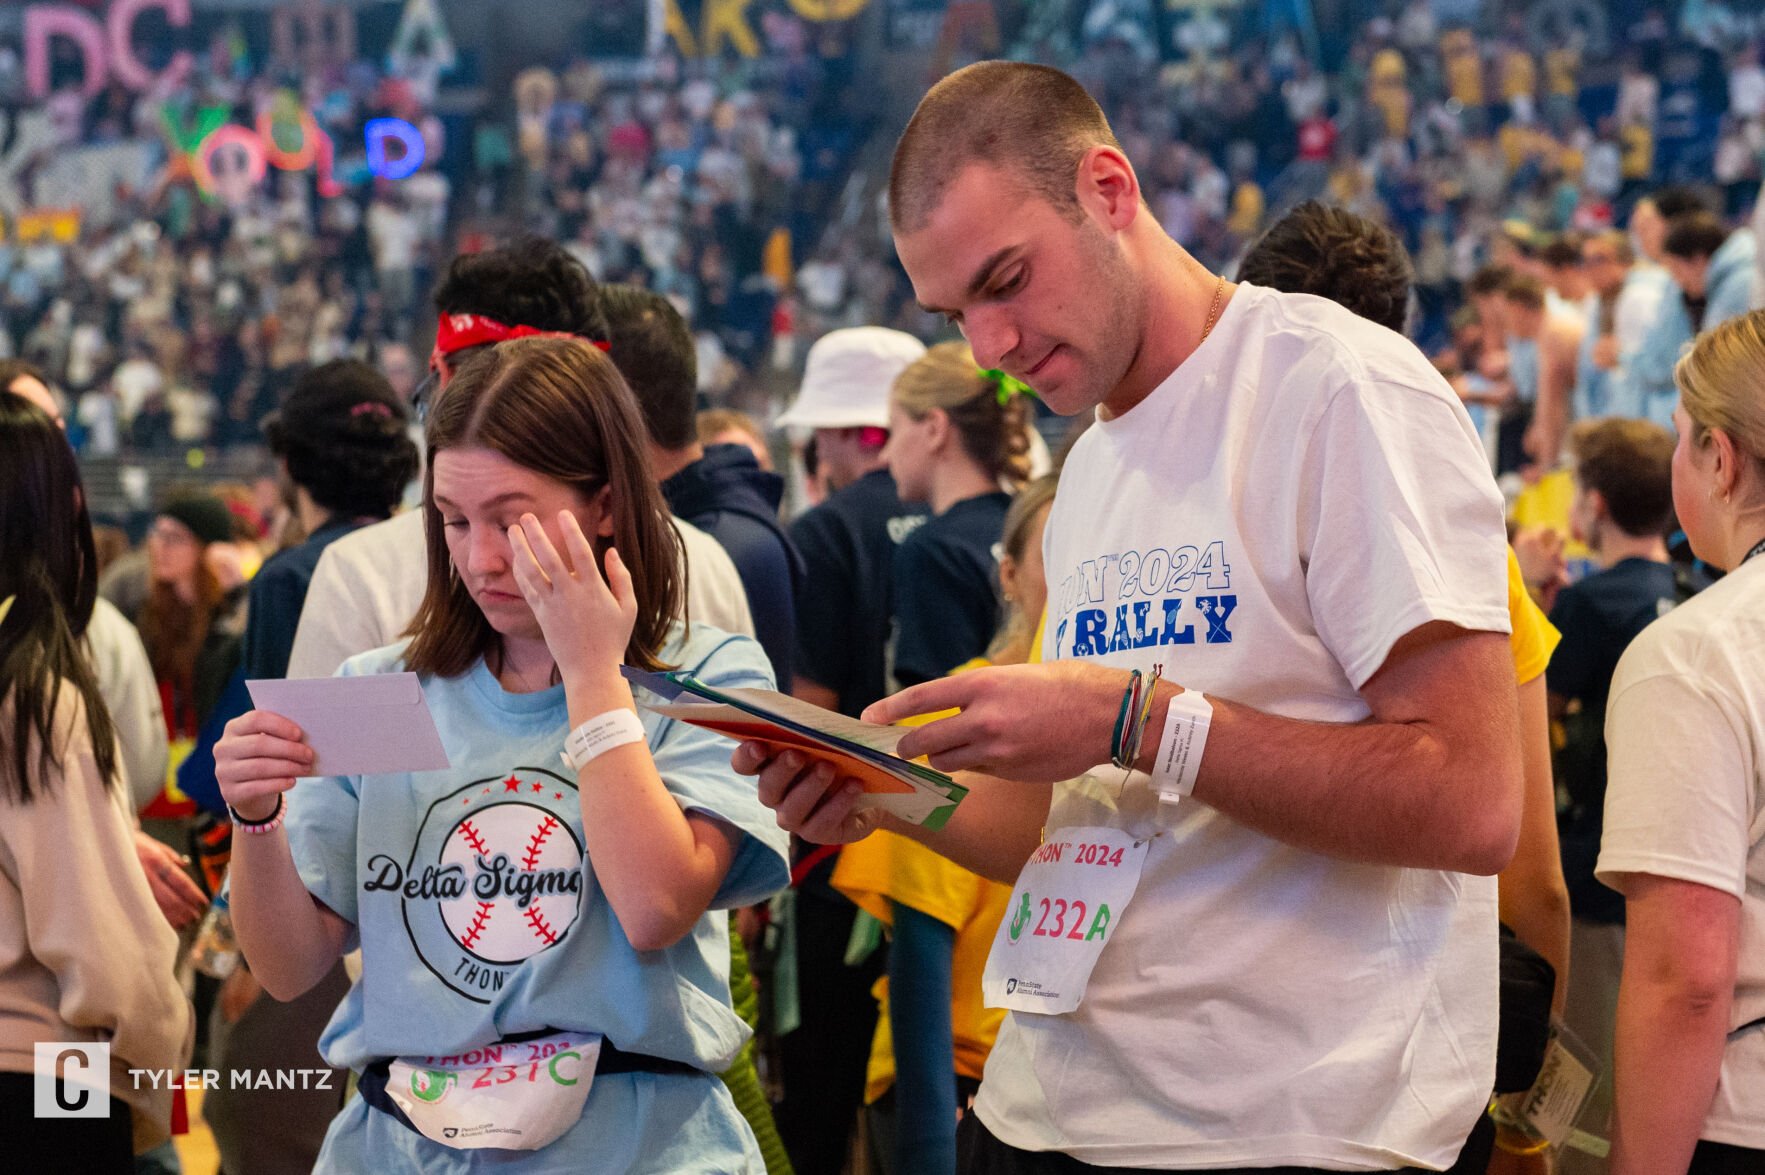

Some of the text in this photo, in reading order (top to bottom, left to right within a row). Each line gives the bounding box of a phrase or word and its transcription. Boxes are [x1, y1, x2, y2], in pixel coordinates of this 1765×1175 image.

[1118, 541, 1231, 600] 2024
[1072, 594, 1238, 658] RALLY
[364, 854, 467, 899] Delta
[1074, 843, 1125, 867] 2024
[1033, 897, 1111, 941] 232A
